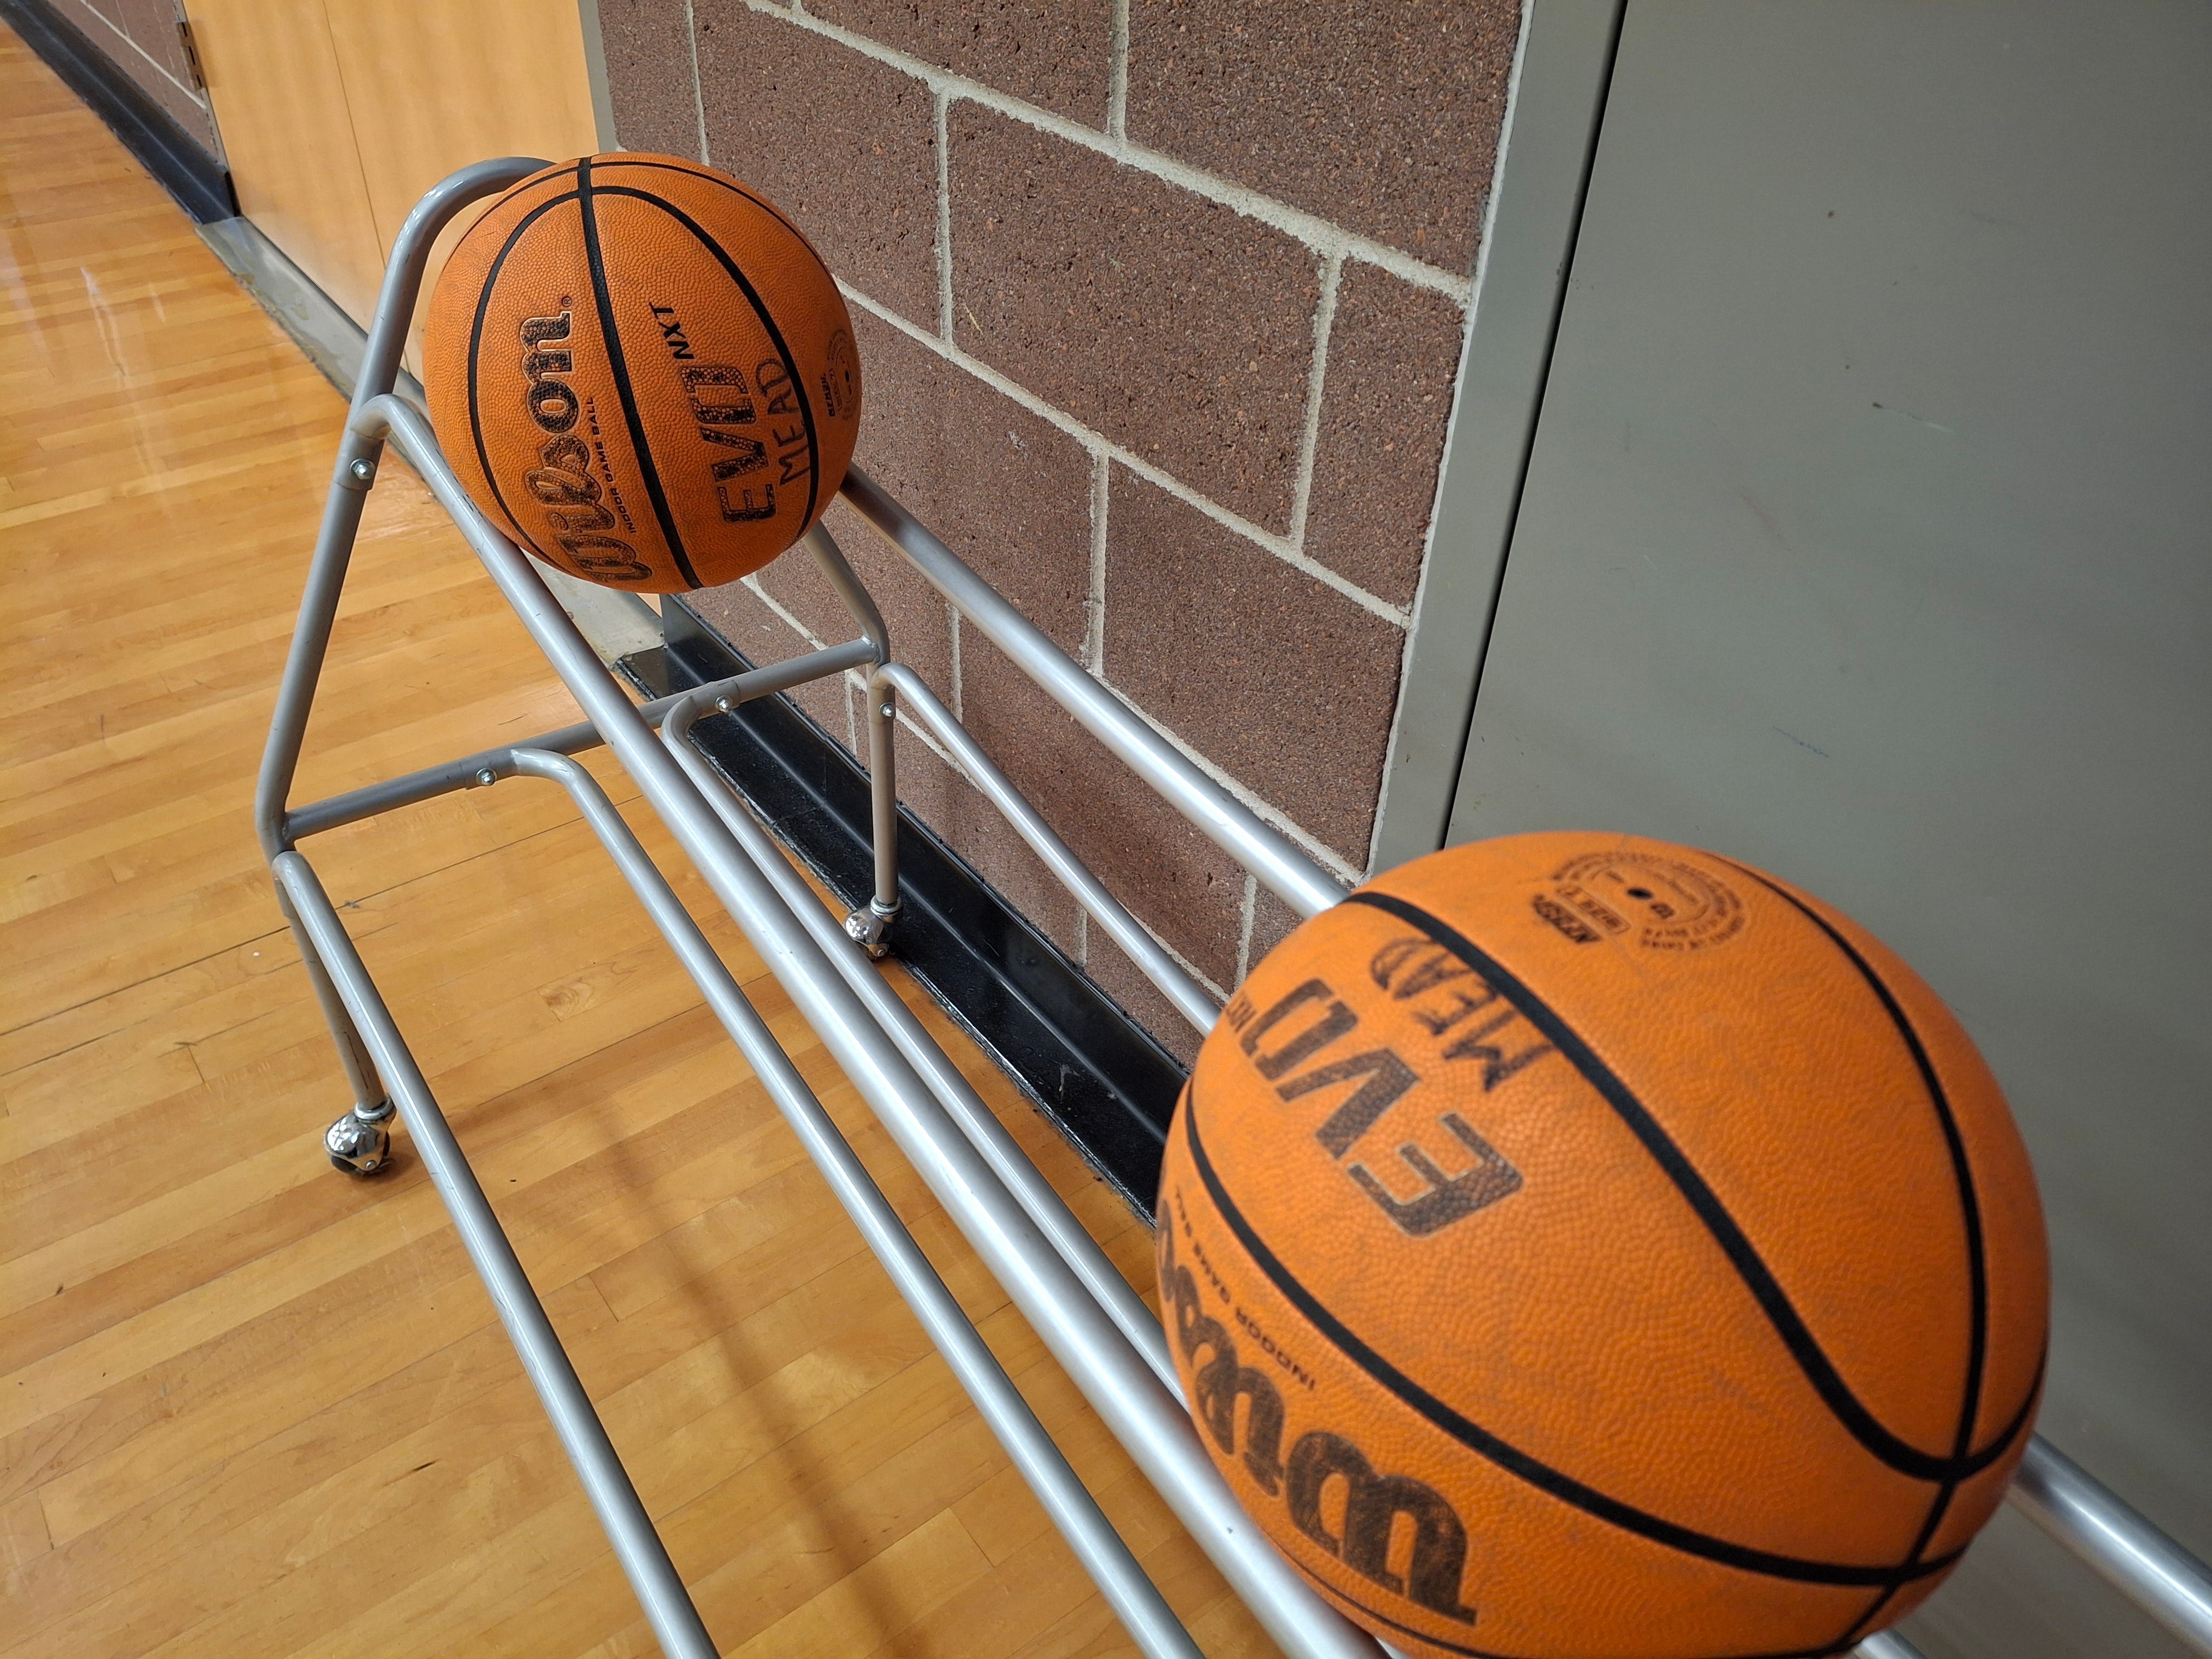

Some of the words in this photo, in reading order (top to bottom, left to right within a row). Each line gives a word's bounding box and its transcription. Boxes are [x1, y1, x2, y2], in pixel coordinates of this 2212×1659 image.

[650, 302, 695, 360] NXT
[520, 310, 653, 582] Wilson
[586, 397, 600, 435] BALL
[595, 441, 614, 483] GAME
[679, 363, 777, 523] EVO
[756, 358, 808, 486] MEAD
[610, 488, 636, 534] INDOOR
[1369, 937, 1560, 1092] MEAD
[1240, 977, 1524, 1238] EVO
[1156, 1199, 1477, 1626] Wilso
[1235, 1307, 1315, 1391] INDOOR
